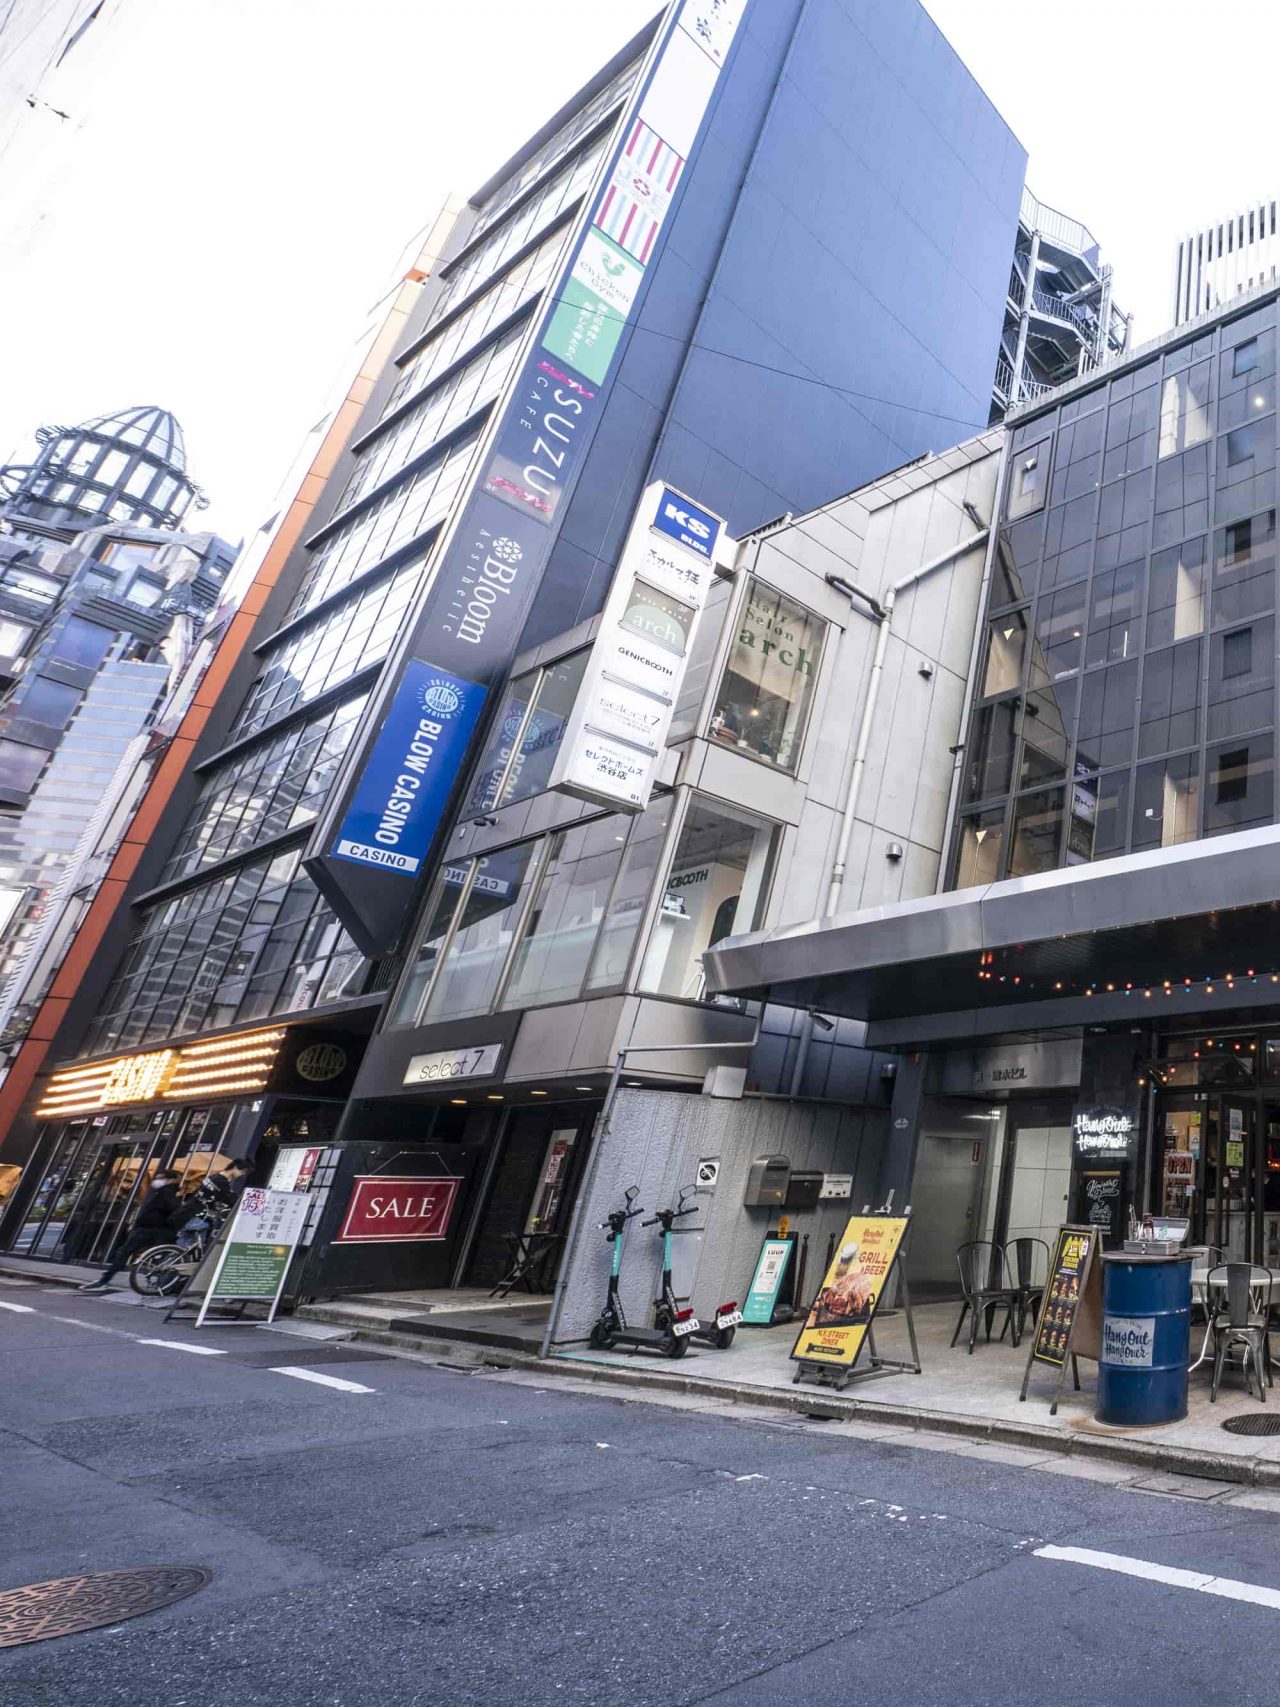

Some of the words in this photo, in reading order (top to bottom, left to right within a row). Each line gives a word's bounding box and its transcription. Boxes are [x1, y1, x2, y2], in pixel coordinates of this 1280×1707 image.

[520, 376, 549, 430] CAFE
[523, 389, 583, 496] SUZU
[664, 503, 711, 539] KS
[442, 528, 492, 632] Aesthetic
[456, 554, 518, 644] Bloom
[633, 614, 676, 644] arch
[618, 647, 673, 677] GENICBOOTH
[739, 629, 813, 677] arch
[403, 718, 442, 774] BLOW
[596, 762, 627, 781] 渋谷店
[374, 774, 421, 845] CASINO
[349, 845, 407, 867] CASINO
[365, 1197, 436, 1219] SALE
[858, 1251, 889, 1264] GRILL
[1104, 1323, 1152, 1346] HangOut
